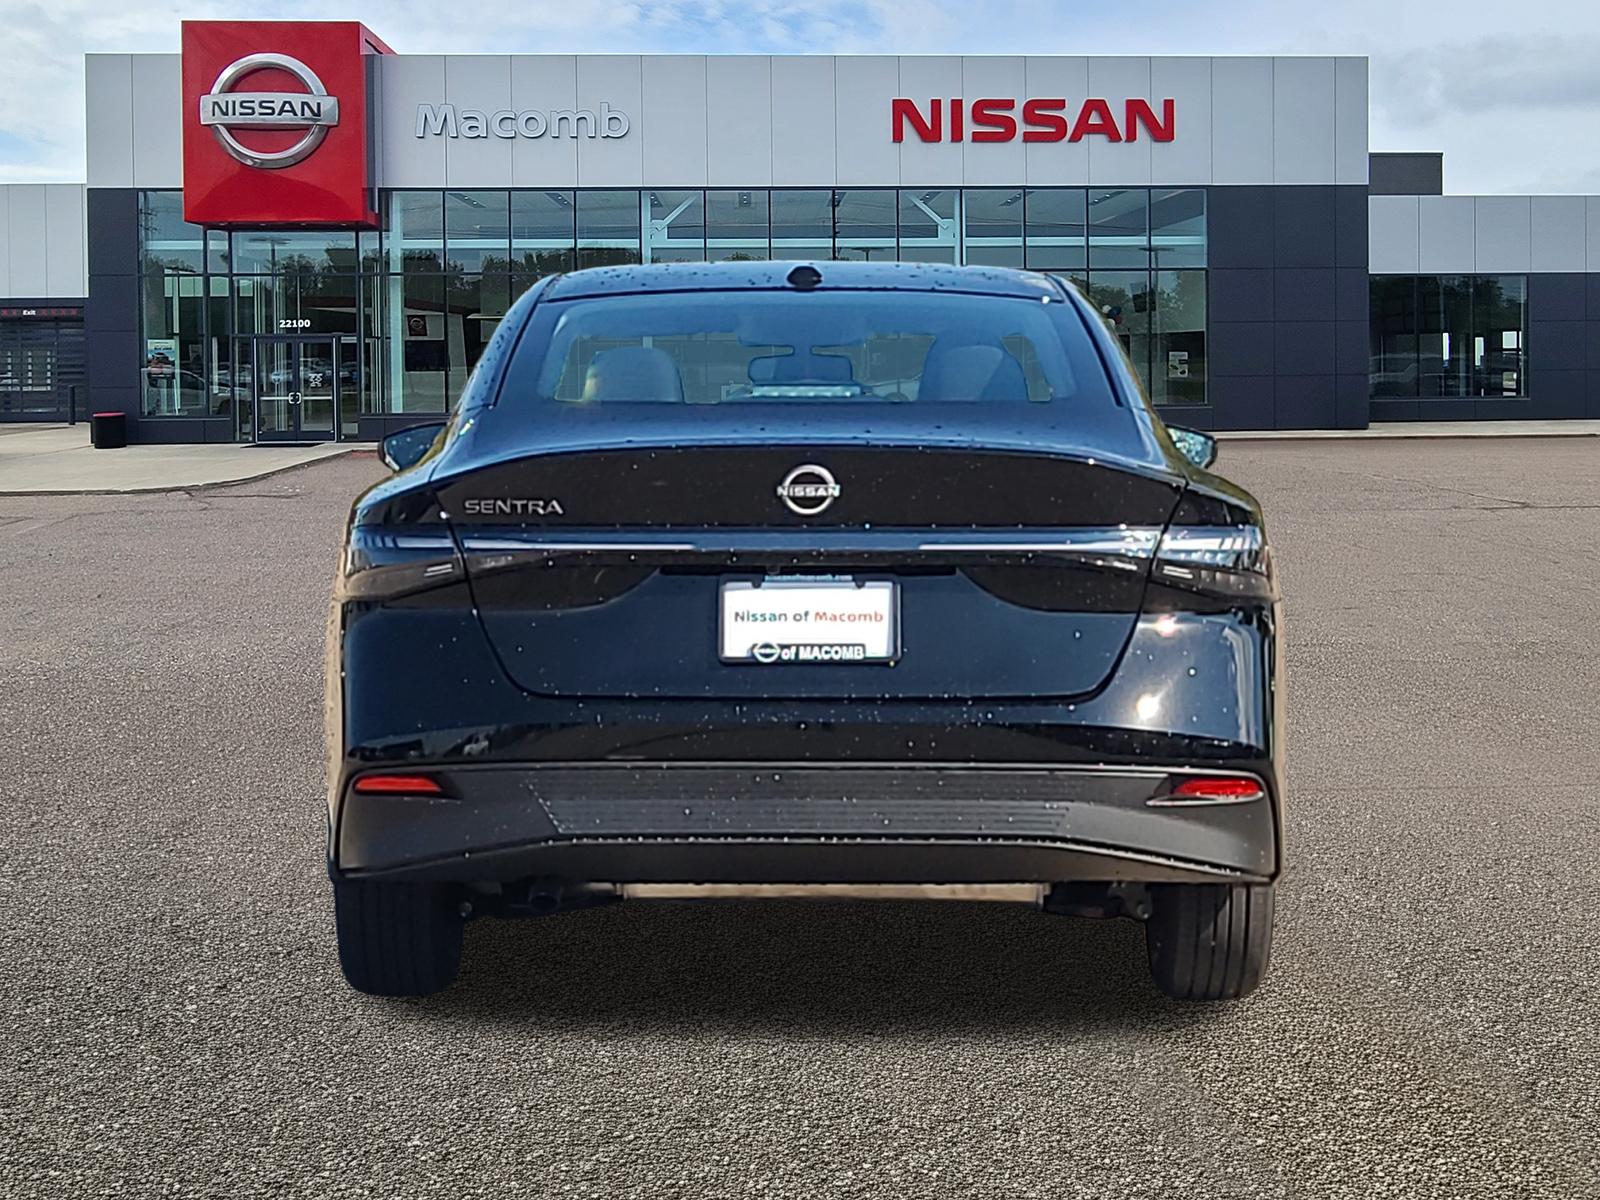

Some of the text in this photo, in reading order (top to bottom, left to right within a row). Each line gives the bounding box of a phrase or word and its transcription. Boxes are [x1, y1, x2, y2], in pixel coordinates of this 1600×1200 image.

[212, 100, 322, 118] NISSAN
[415, 101, 630, 139] Macomb
[892, 98, 1175, 143] NISSAN
[279, 319, 311, 328] 22100
[776, 484, 841, 498] NISSAN
[464, 497, 564, 515] SENTRA
[734, 610, 884, 622] Nissan of Macomb
[781, 645, 865, 660] of MACOMB
